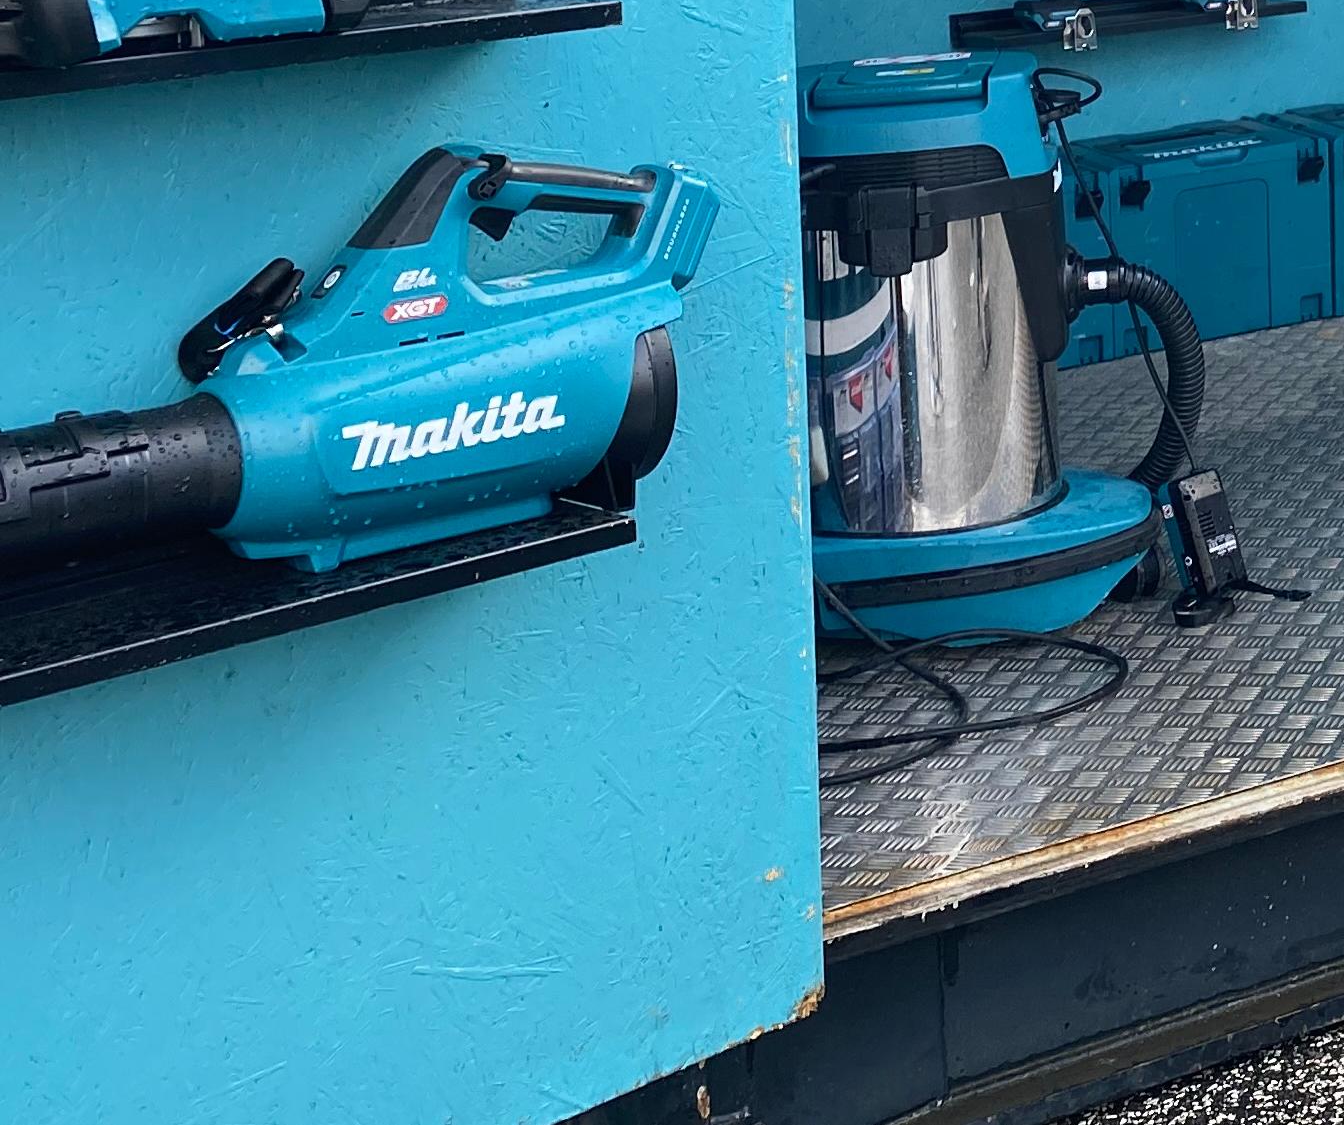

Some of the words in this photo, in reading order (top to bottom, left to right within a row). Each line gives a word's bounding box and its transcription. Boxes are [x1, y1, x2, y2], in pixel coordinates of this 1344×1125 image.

[1142, 138, 1262, 158] Makita
[664, 198, 690, 261] BRUSHLESS
[390, 296, 441, 321] XGT
[342, 391, 566, 470] Makita
